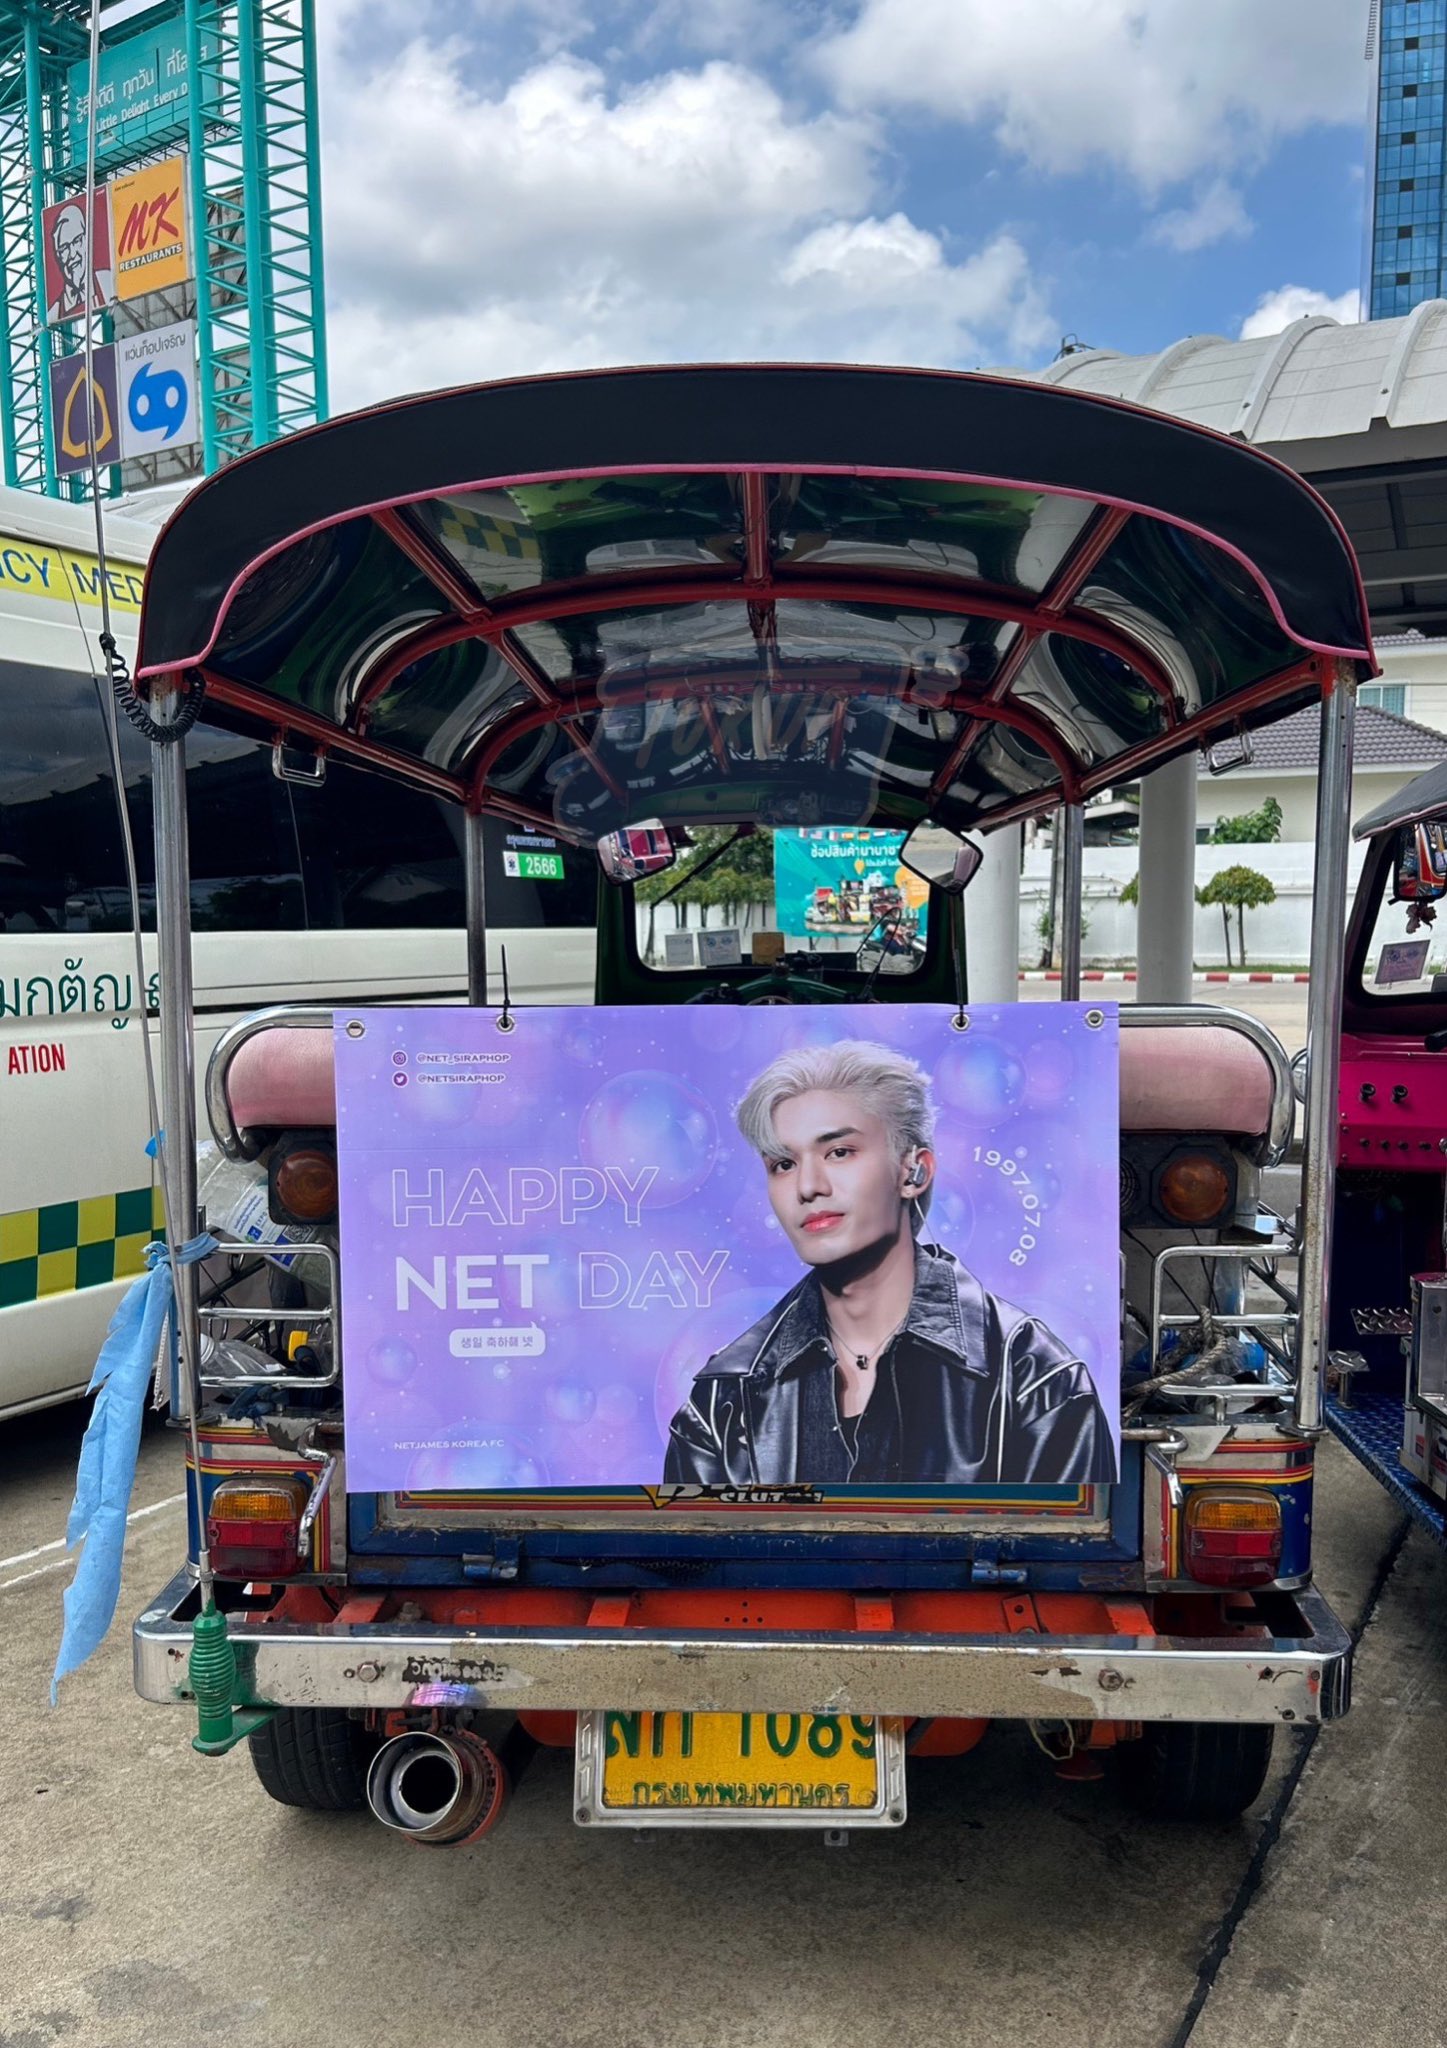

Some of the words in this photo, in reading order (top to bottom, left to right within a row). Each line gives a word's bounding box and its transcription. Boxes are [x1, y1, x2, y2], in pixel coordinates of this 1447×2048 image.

[122, 69, 155, 100] ทุกวัน
[96, 113, 118, 132] Little
[153, 88, 179, 107] Every
[118, 186, 180, 257] MK
[119, 244, 183, 272] RESTAURANTS
[125, 334, 186, 361] แว่นท็อปเจริญ
[0, 549, 50, 587] CY
[811, 842, 901, 858] ช้อปสินค้านานาช
[526, 856, 557, 876] 2566
[8, 1044, 66, 1075] ATION
[417, 1053, 511, 1064] @NET_SIRAPHOP
[417, 1073, 505, 1084] @NETSIRAPHOP
[392, 1166, 660, 1227] HAPPY
[973, 1146, 1041, 1266] 1997.07.08
[396, 1254, 549, 1311] NET
[579, 1250, 730, 1309] DAY
[461, 1336, 482, 1349] 생일
[487, 1336, 519, 1348] 축하해
[523, 1336, 533, 1348] 넷
[394, 1441, 449, 1450] NETJAMES
[451, 1440, 489, 1449] KOREA
[490, 1439, 505, 1448] FC
[719, 1491, 823, 1503] CLUT
[632, 1781, 850, 1808] กรงเทพมหานคร
